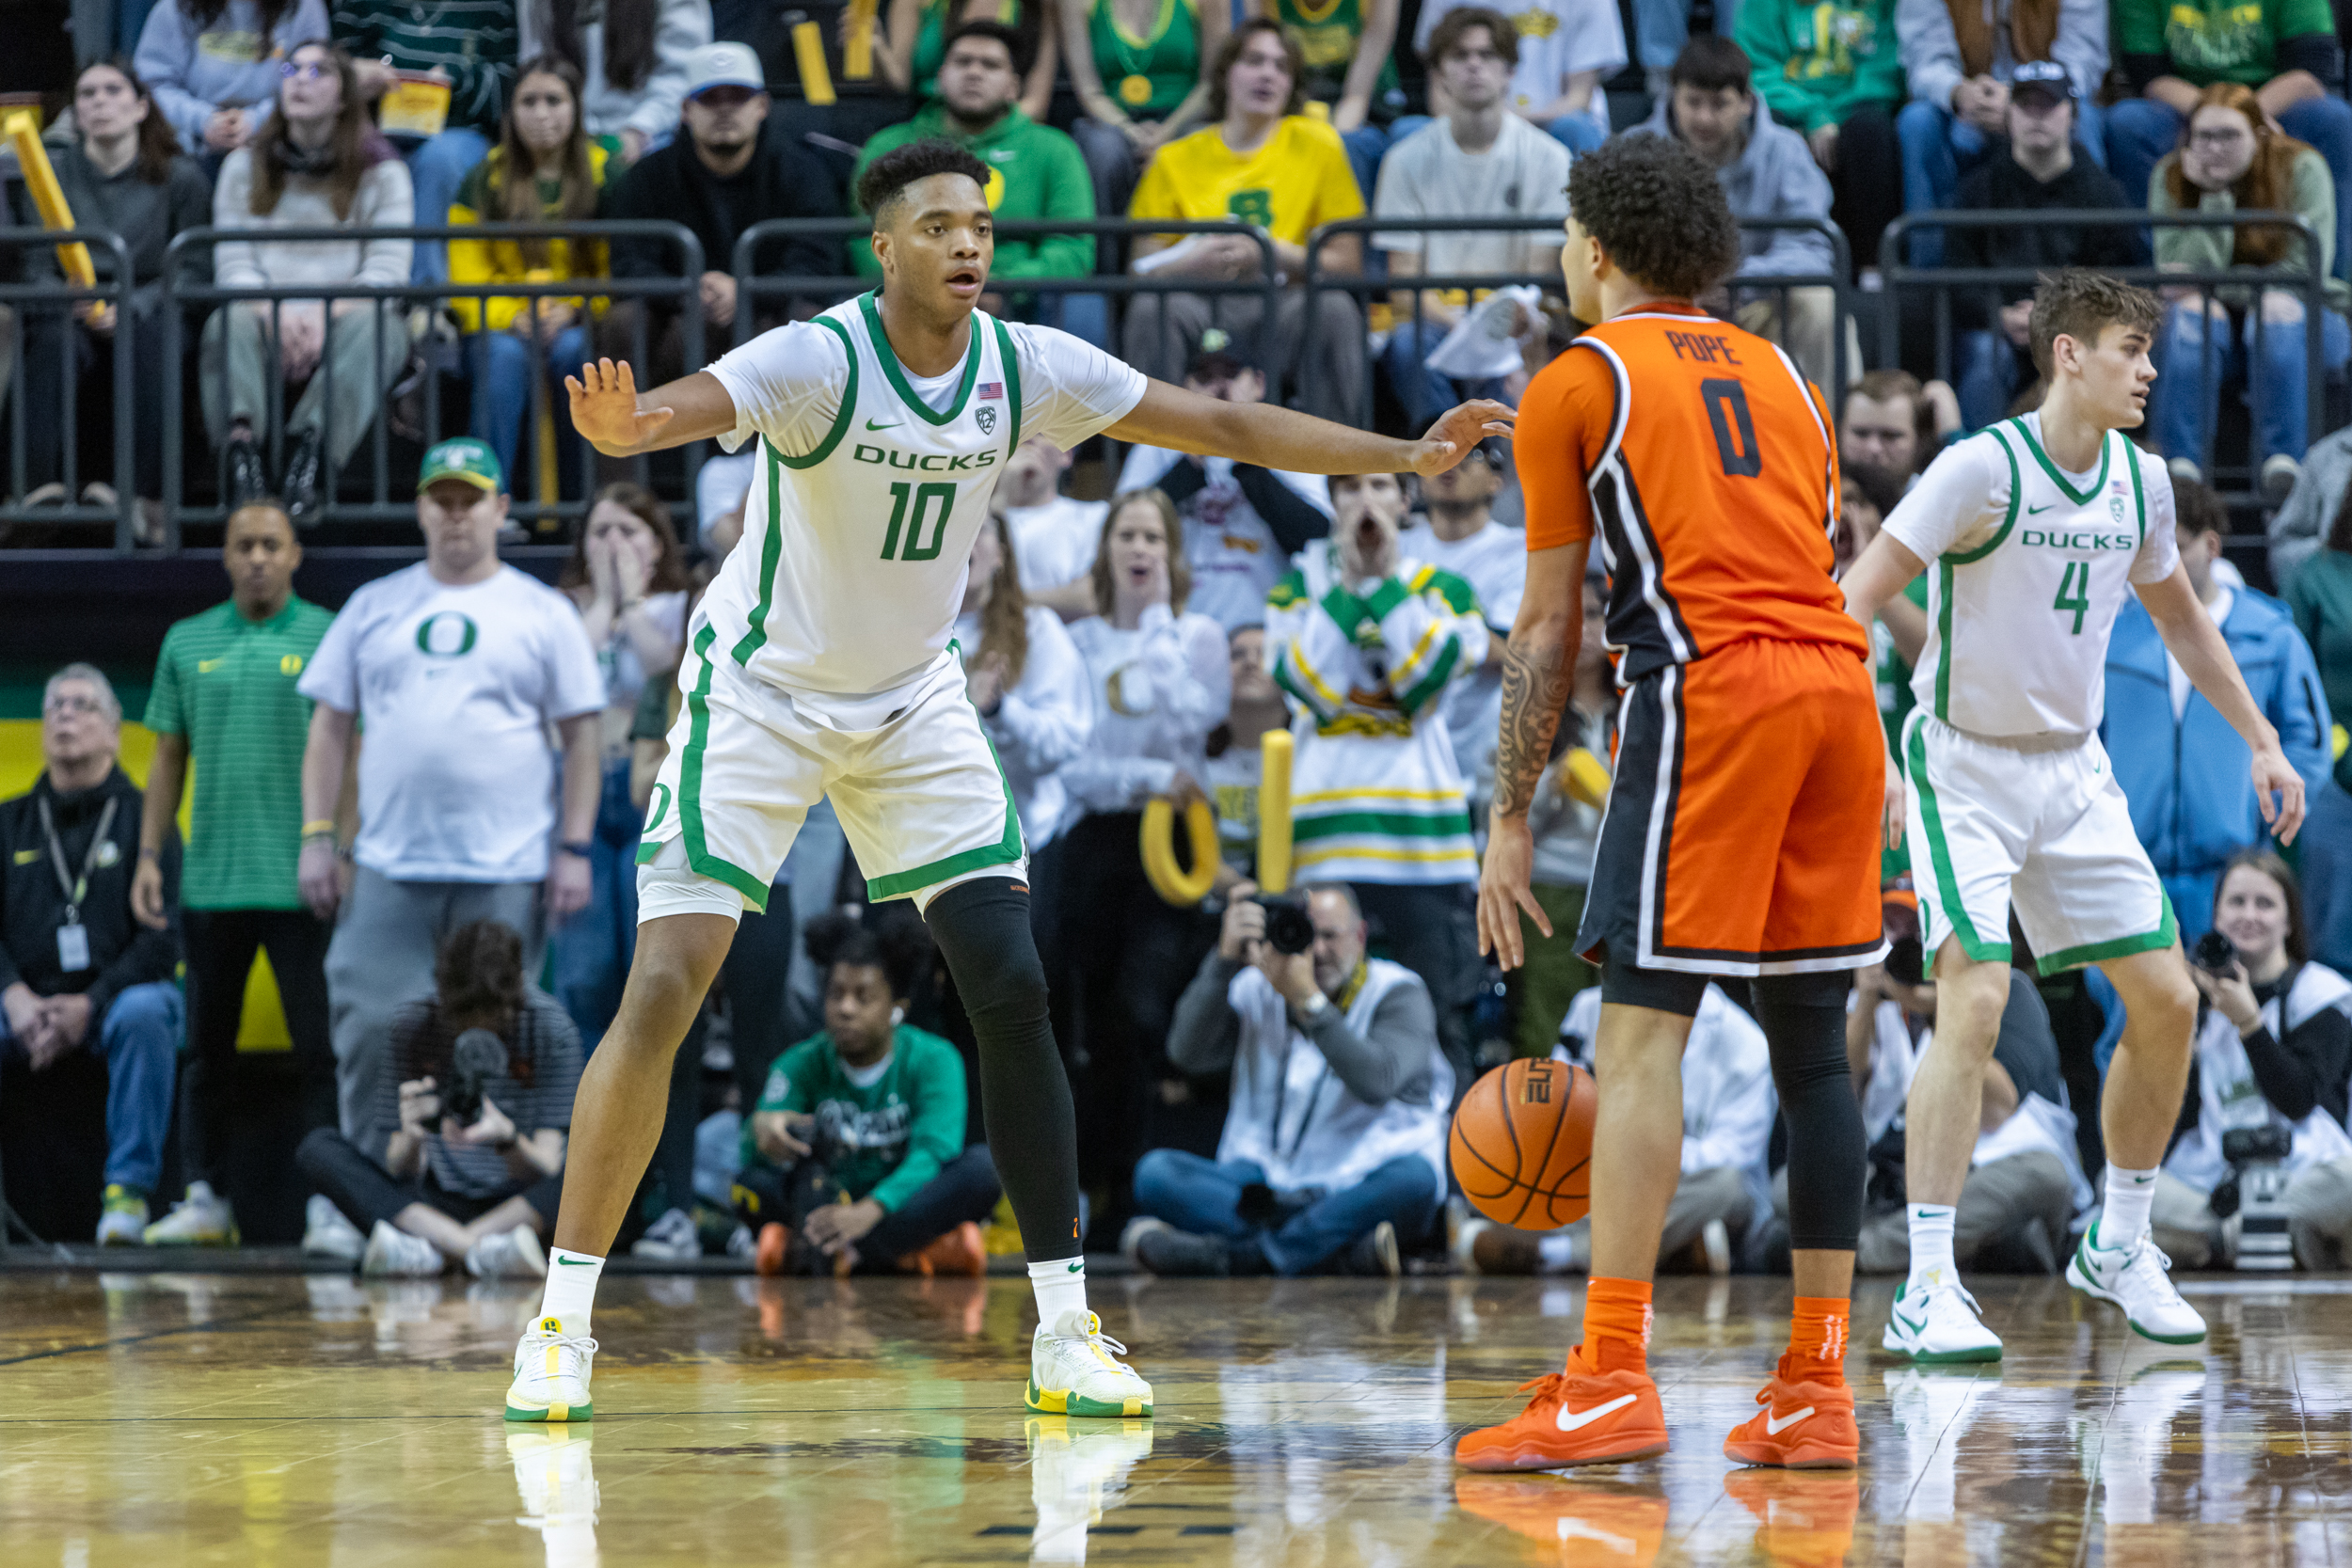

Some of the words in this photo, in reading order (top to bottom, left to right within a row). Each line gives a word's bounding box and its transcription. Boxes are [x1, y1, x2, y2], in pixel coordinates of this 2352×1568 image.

[1664, 330, 1743, 365] POPE
[977, 407, 994, 423] PAC
[982, 419, 993, 428] 12
[1700, 378, 1763, 479] 0
[853, 444, 997, 470] DUCKS
[881, 482, 957, 561] 10
[2022, 530, 2133, 550] DUCKS
[2054, 562, 2089, 635] 4
